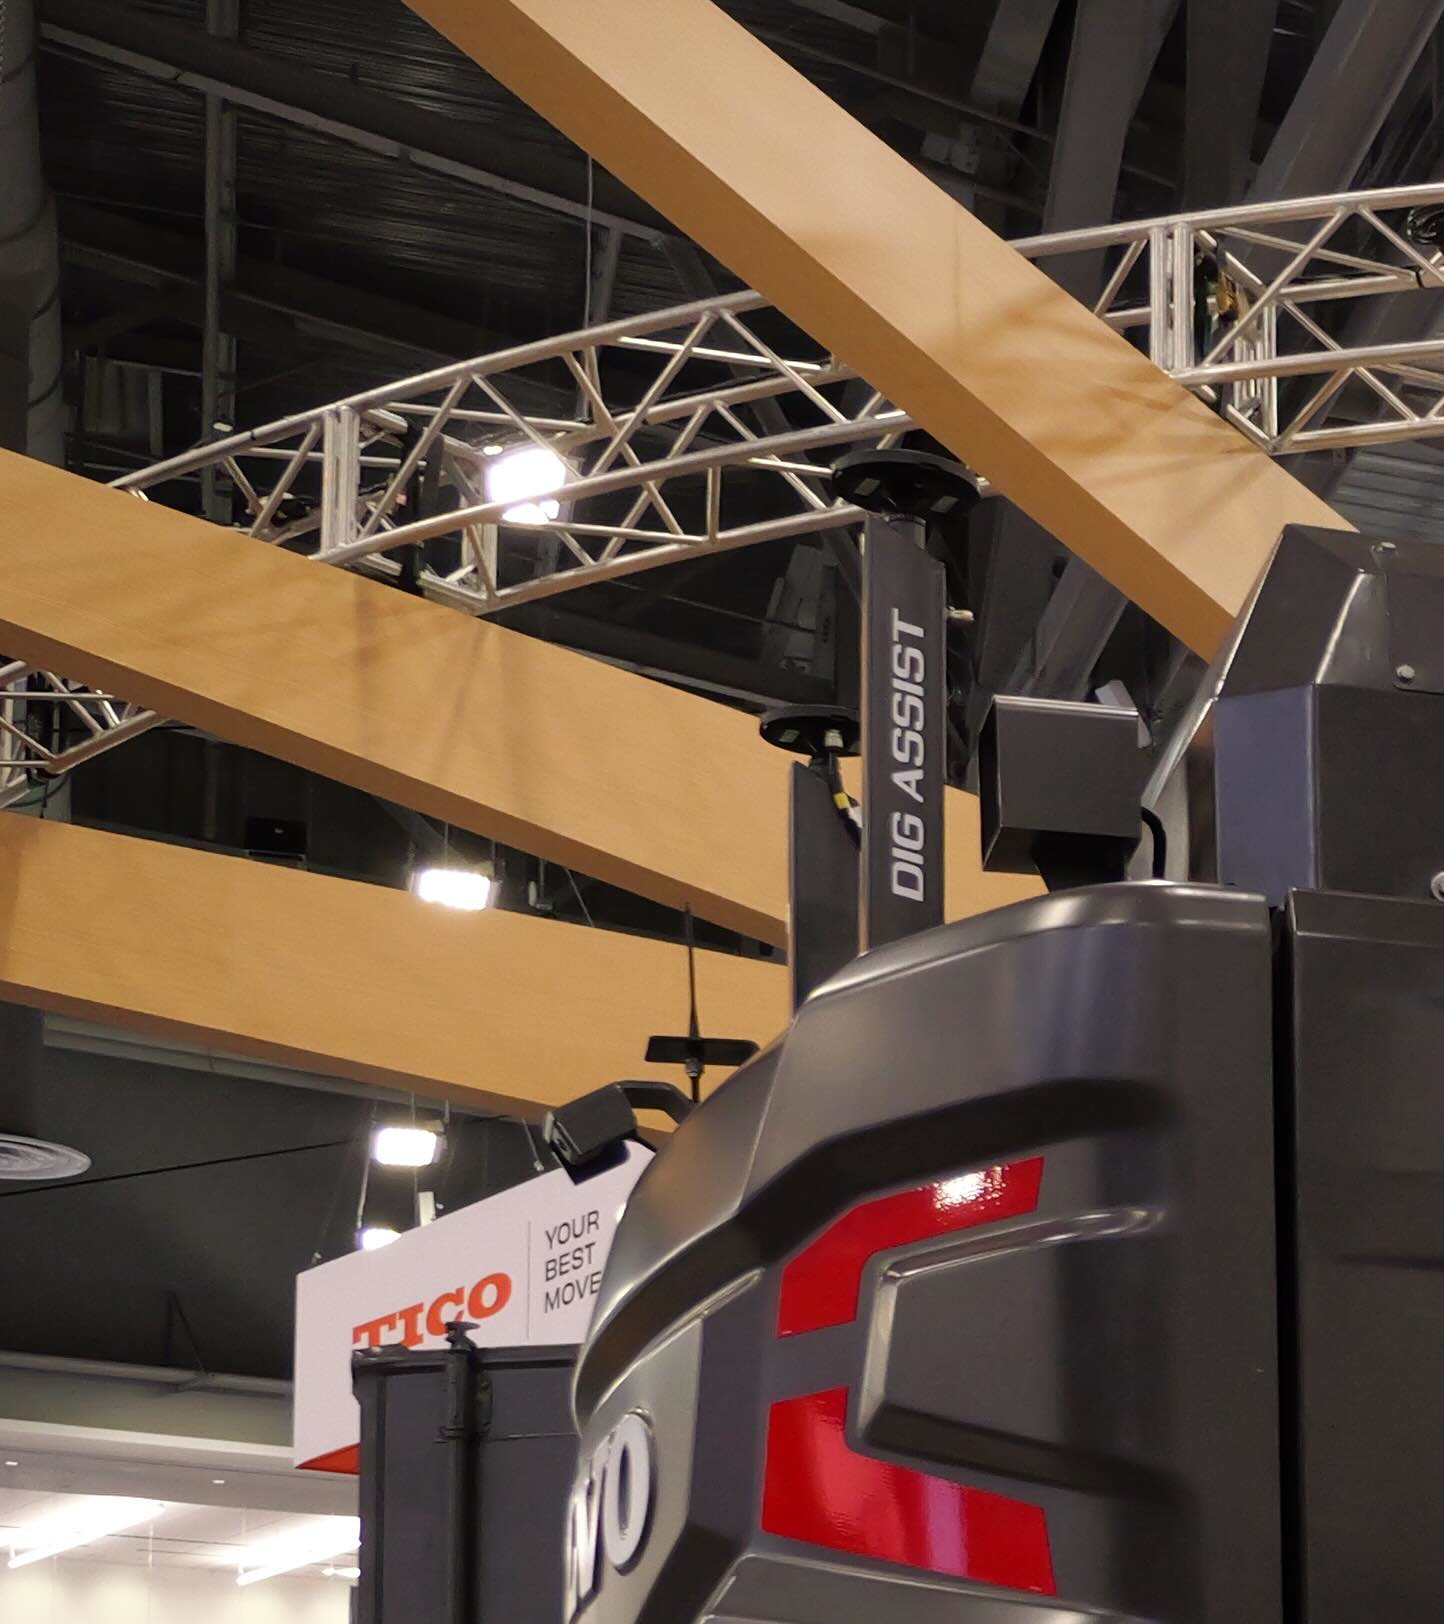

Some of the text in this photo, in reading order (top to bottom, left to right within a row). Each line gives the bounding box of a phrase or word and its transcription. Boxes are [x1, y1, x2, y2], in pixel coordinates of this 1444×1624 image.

[889, 608, 927, 903] DIG ASSIST
[544, 1210, 600, 1250] YOUR
[545, 1242, 596, 1282] BEST
[352, 1272, 512, 1349] TICO
